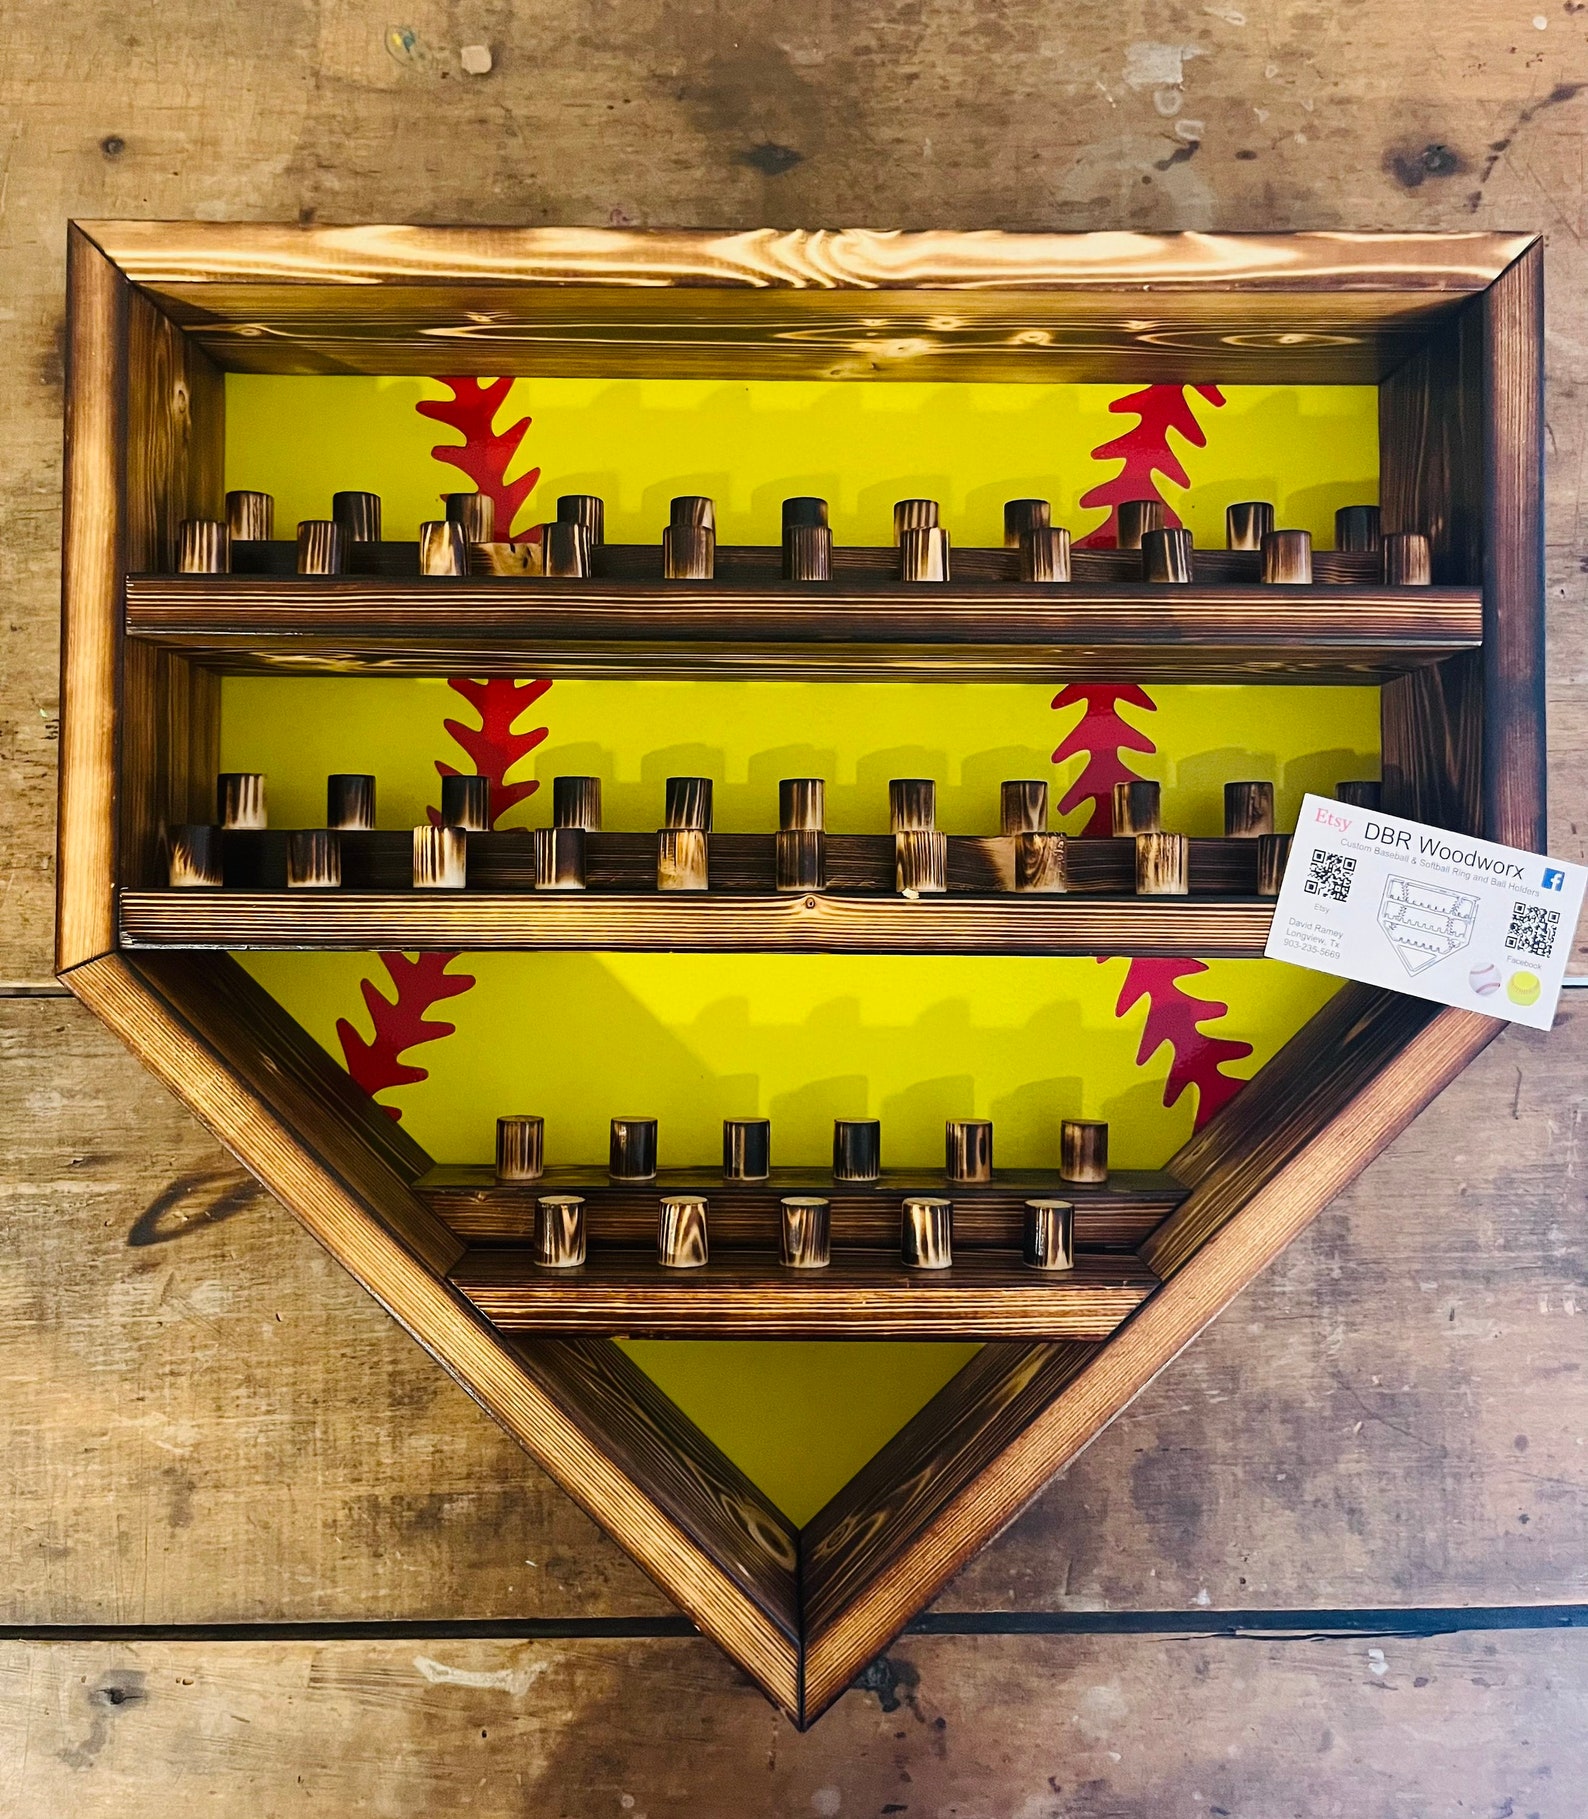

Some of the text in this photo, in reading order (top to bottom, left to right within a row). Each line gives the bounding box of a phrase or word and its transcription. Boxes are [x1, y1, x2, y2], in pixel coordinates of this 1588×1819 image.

[1315, 808, 1352, 831] Etsy
[1364, 822, 1525, 880] DBR Woodworx
[1341, 838, 1540, 897] Custom Baseball & Softball Ring and Ball Holders
[1314, 904, 1329, 914] Etsy
[1289, 918, 1343, 939] David Ramey
[1284, 938, 1340, 959] 903-235-5669
[1330, 938, 1340, 948] Tx
[1507, 955, 1542, 969] Facebook
